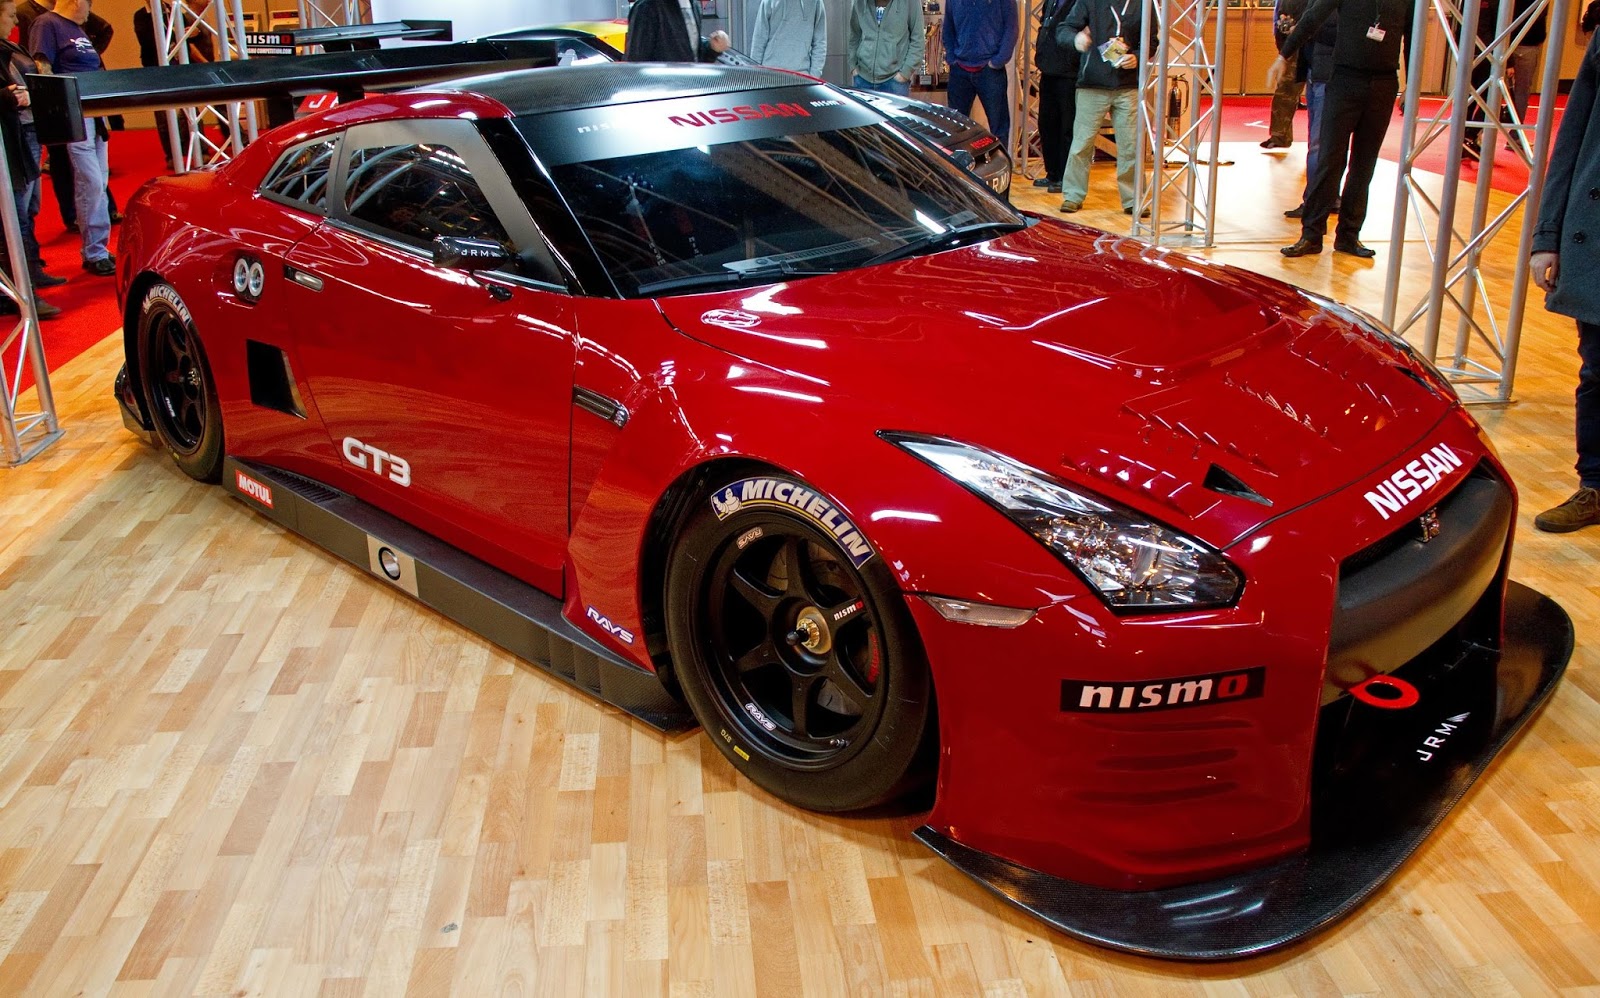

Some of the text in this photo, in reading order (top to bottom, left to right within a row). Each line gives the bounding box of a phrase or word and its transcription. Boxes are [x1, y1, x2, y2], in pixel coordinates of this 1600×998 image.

[668, 102, 811, 128] NISSAN
[461, 249, 489, 258] JRM
[149, 286, 190, 322] MICHELIN
[342, 436, 411, 488] GT3
[238, 474, 272, 504] MOTUL
[1363, 442, 1463, 520] NISSAN
[741, 479, 871, 557] MICHELIN
[736, 526, 763, 549] RAYS
[586, 605, 635, 644] RAYS
[833, 601, 864, 621] nismo
[1079, 674, 1248, 708] nismo
[745, 703, 776, 731] RAYS
[1416, 722, 1458, 761] JRM
